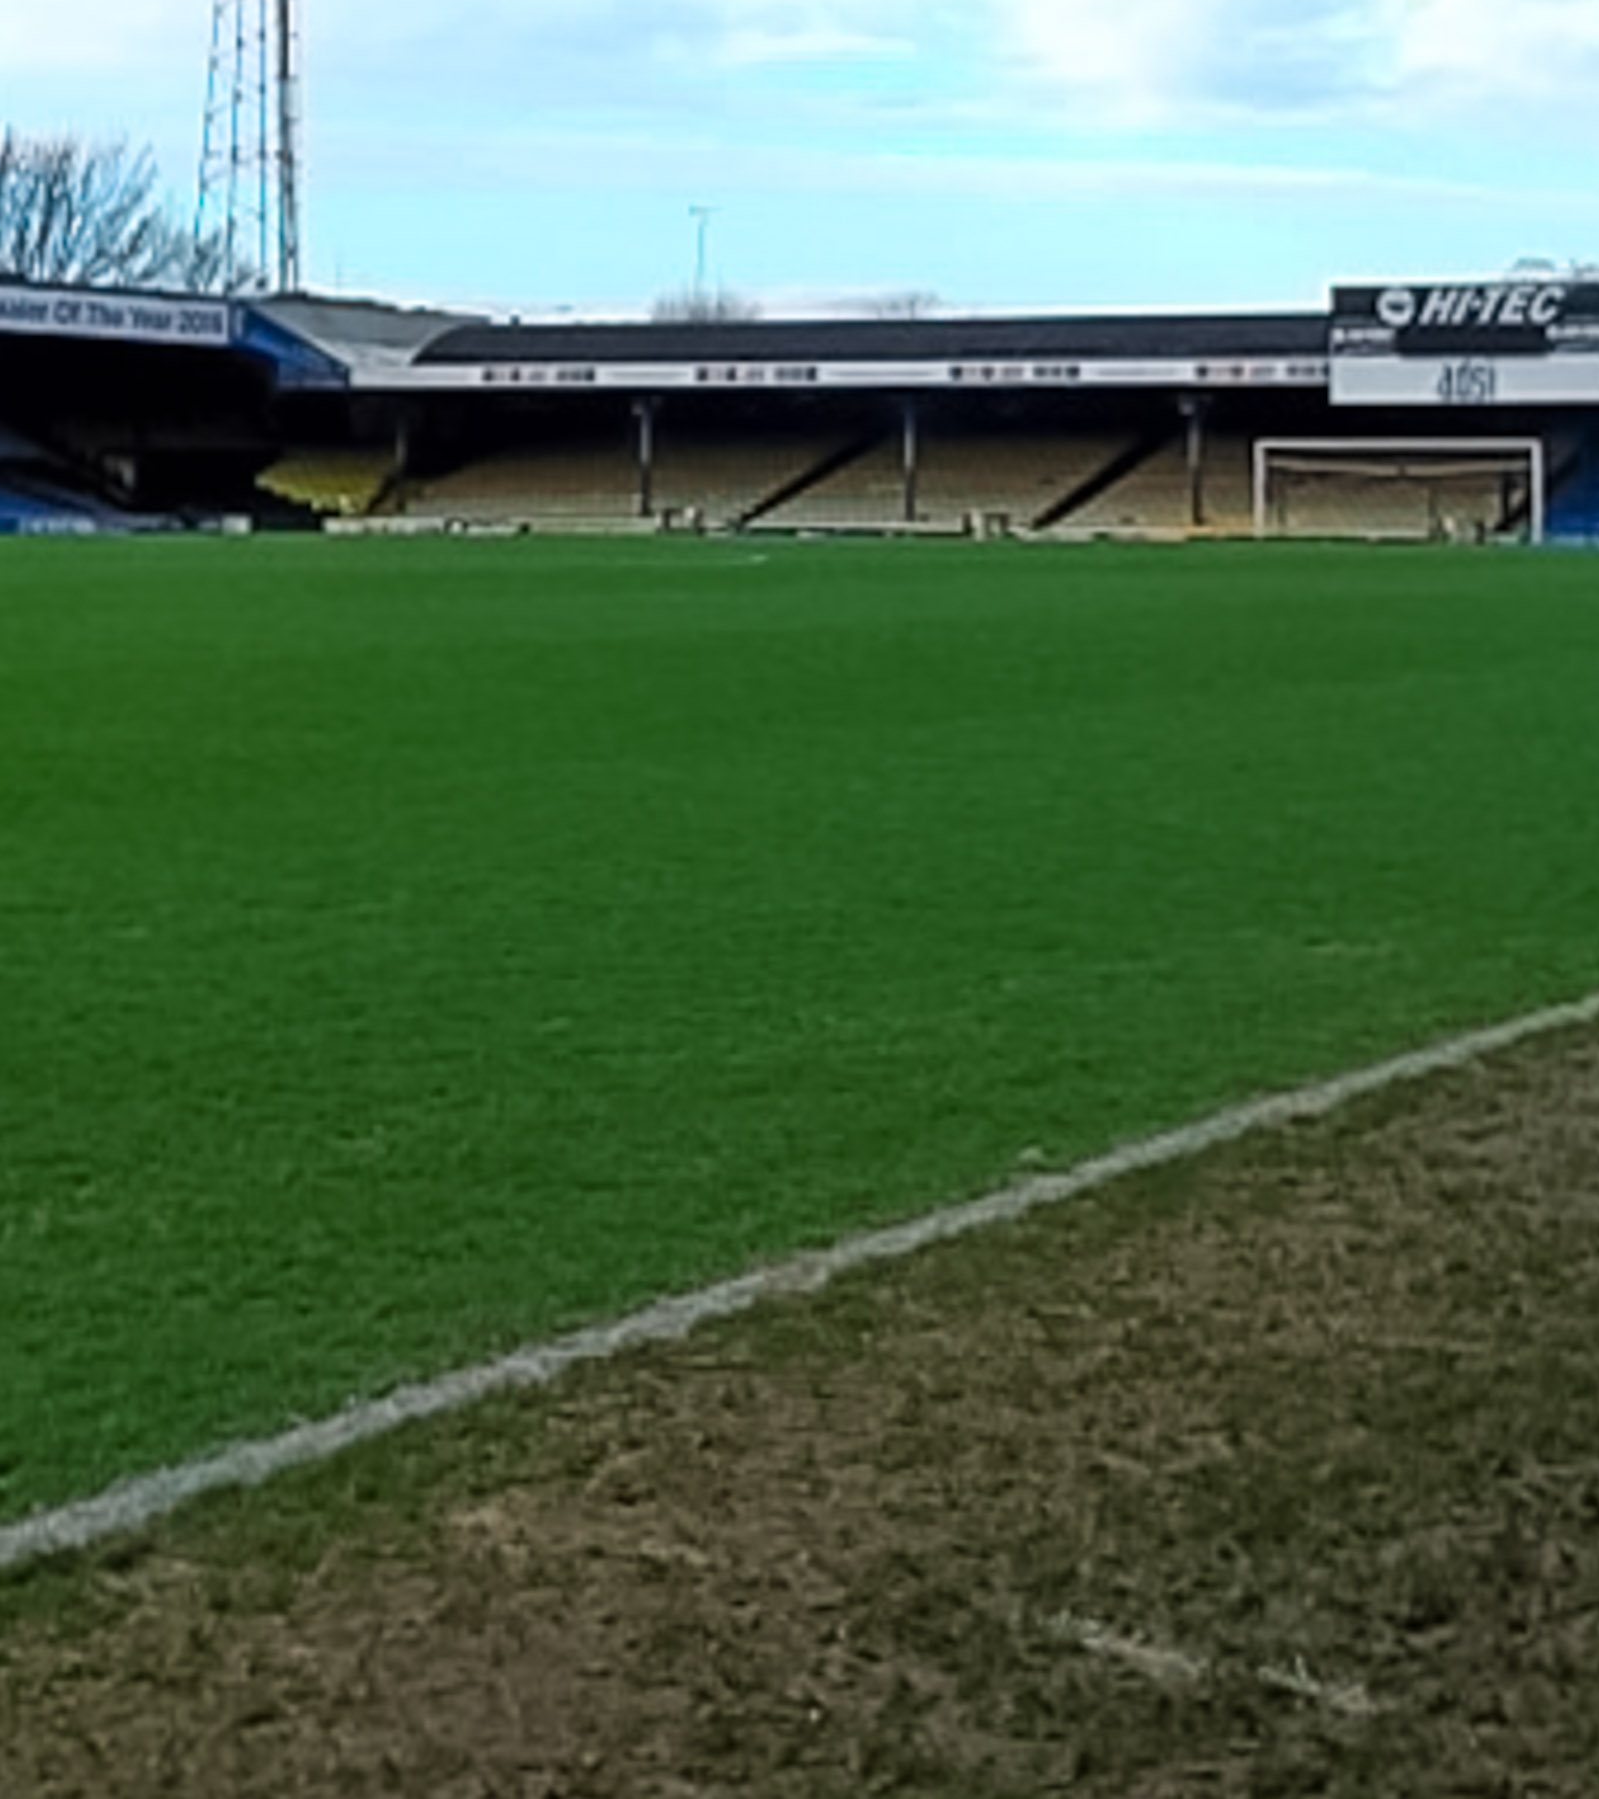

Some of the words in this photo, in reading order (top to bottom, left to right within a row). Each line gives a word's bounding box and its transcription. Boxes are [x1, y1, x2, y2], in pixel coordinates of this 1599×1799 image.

[53, 300, 83, 325] Of
[85, 302, 123, 328] The
[128, 305, 173, 331] Year
[1418, 285, 1565, 325] HI-TEC
